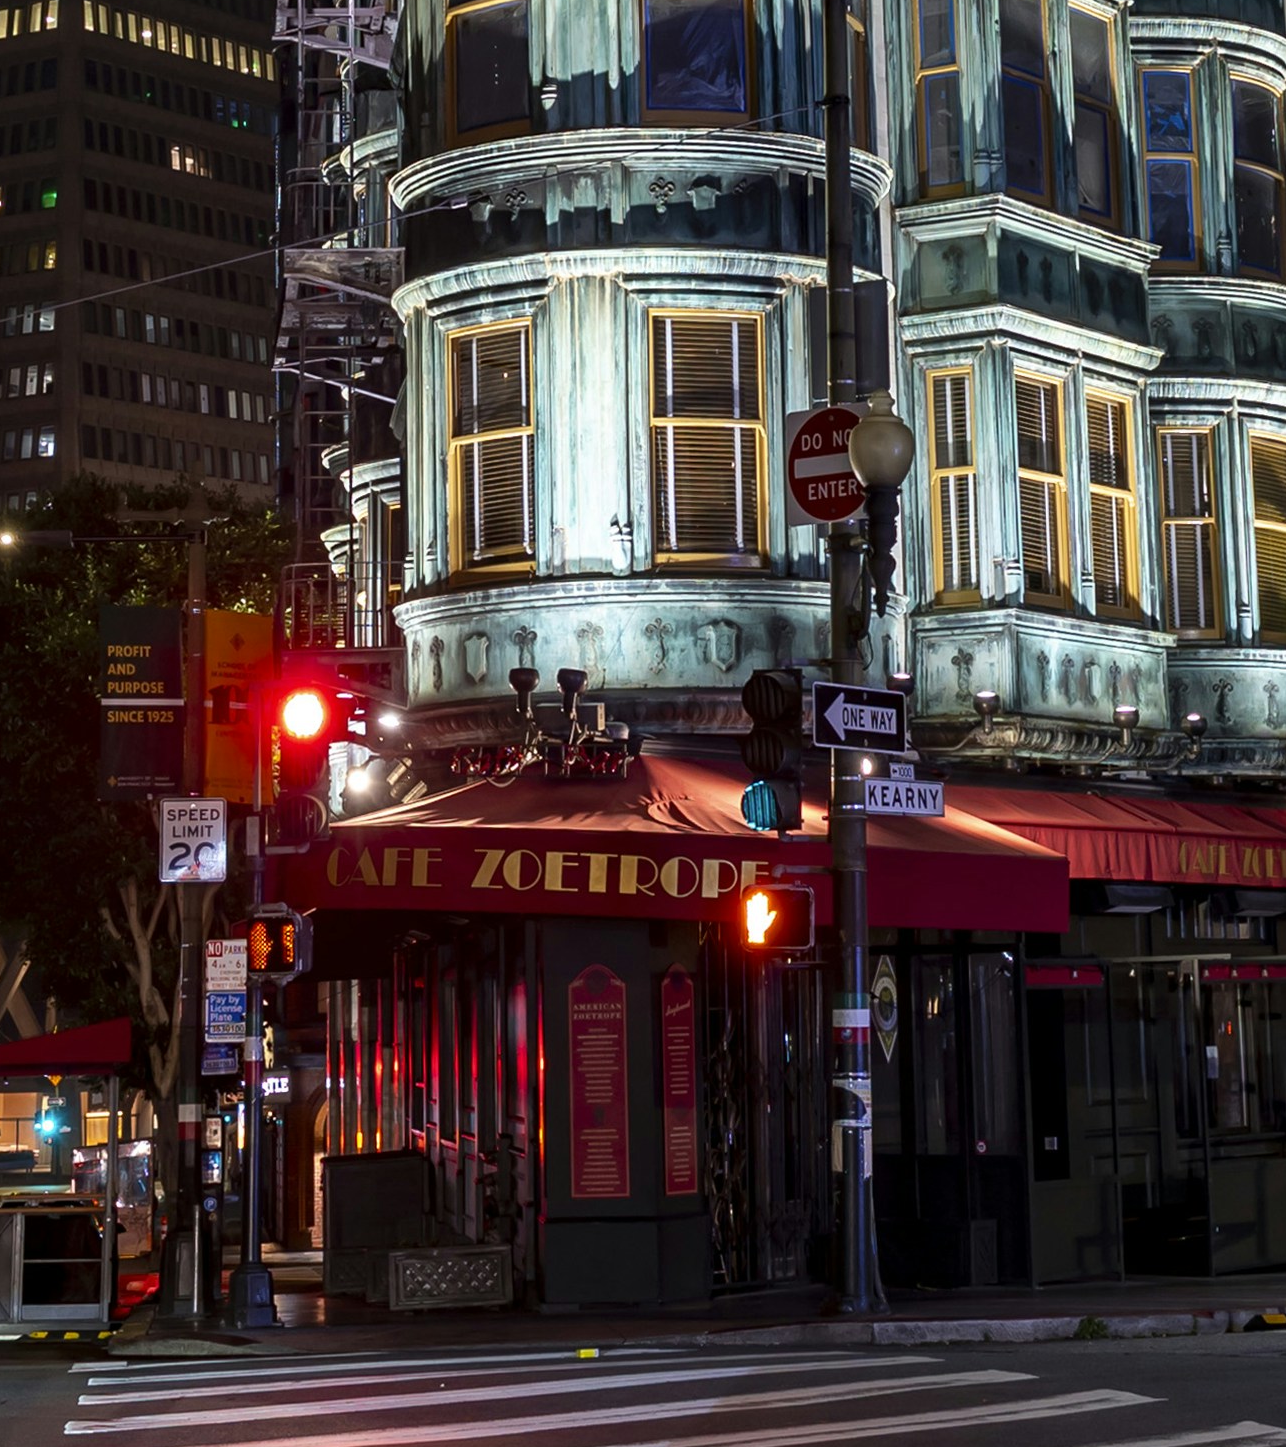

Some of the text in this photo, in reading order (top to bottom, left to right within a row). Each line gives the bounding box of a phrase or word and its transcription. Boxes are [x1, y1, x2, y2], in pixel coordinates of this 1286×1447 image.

[802, 429, 851, 451] DO NO
[809, 479, 858, 501] ENTER
[107, 645, 152, 658] PROFIT
[107, 663, 136, 676] AND
[107, 681, 165, 694] PURPOSE
[107, 711, 175, 723] SINCE 1925
[842, 707, 894, 731] ONE WAY
[898, 767, 912, 777] 1000
[868, 785, 939, 810] KEARNY
[167, 809, 220, 821] SPEED
[173, 825, 213, 838] LIMIT
[1179, 841, 1230, 875] CAFE
[326, 847, 770, 899] CAFE ZOETROPE
[208, 942, 246, 955] NO PARKI
[210, 995, 240, 1005] Pay by
[210, 1005, 243, 1013] License
[573, 1003, 622, 1011] AMERICAN
[210, 1013, 233, 1022] Plate
